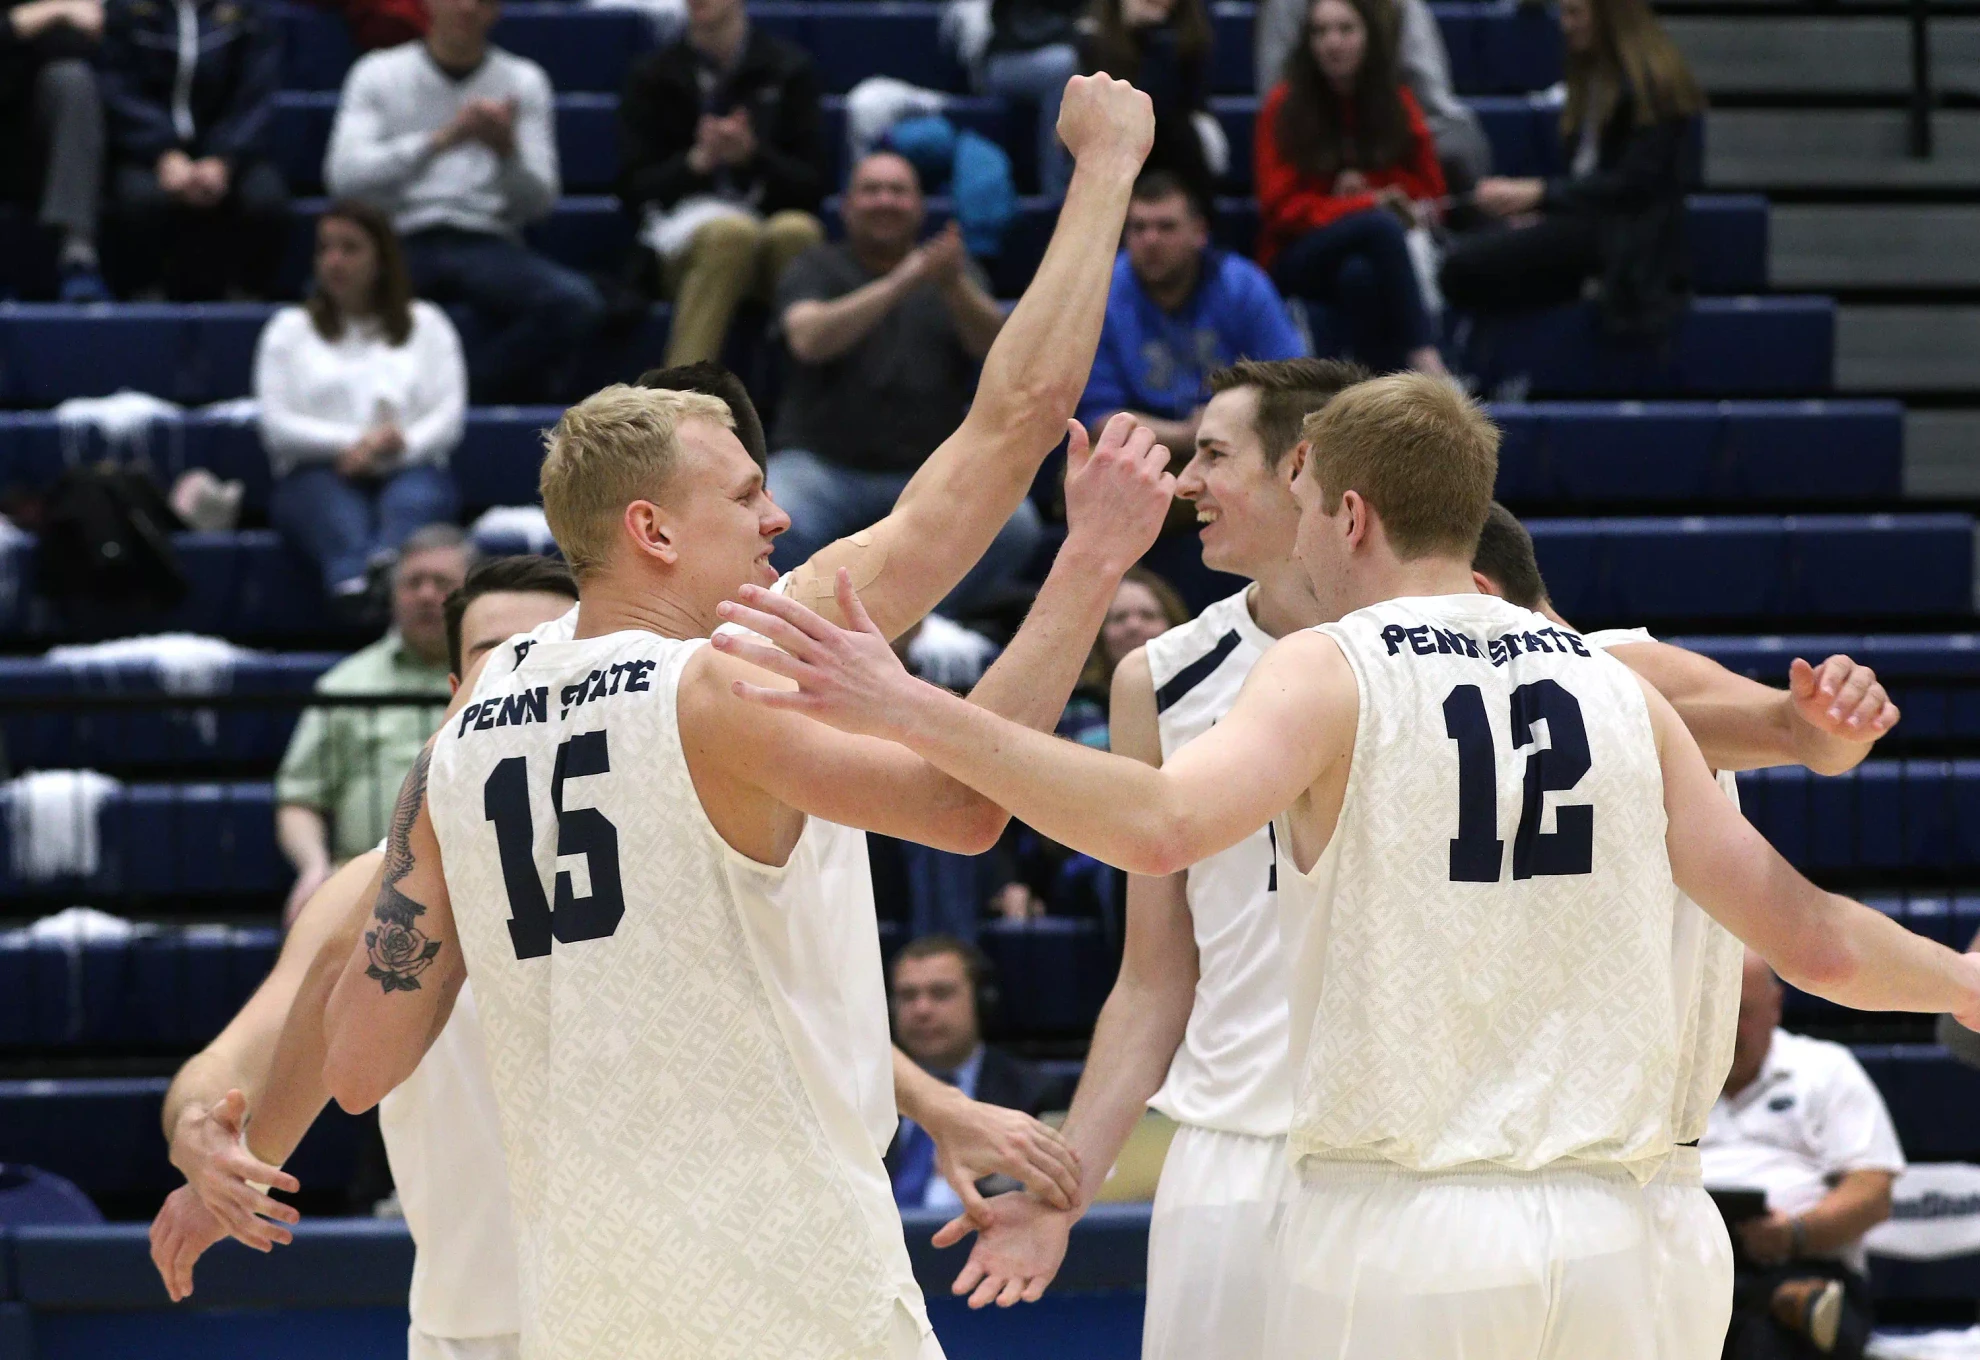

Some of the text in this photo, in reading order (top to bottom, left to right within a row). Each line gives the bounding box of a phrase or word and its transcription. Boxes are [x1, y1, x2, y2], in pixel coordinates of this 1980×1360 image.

[458, 659, 657, 739] PENN STATE
[1380, 624, 1592, 668] PENN STATE
[483, 728, 626, 961] 15
[1442, 678, 1594, 882] 12
